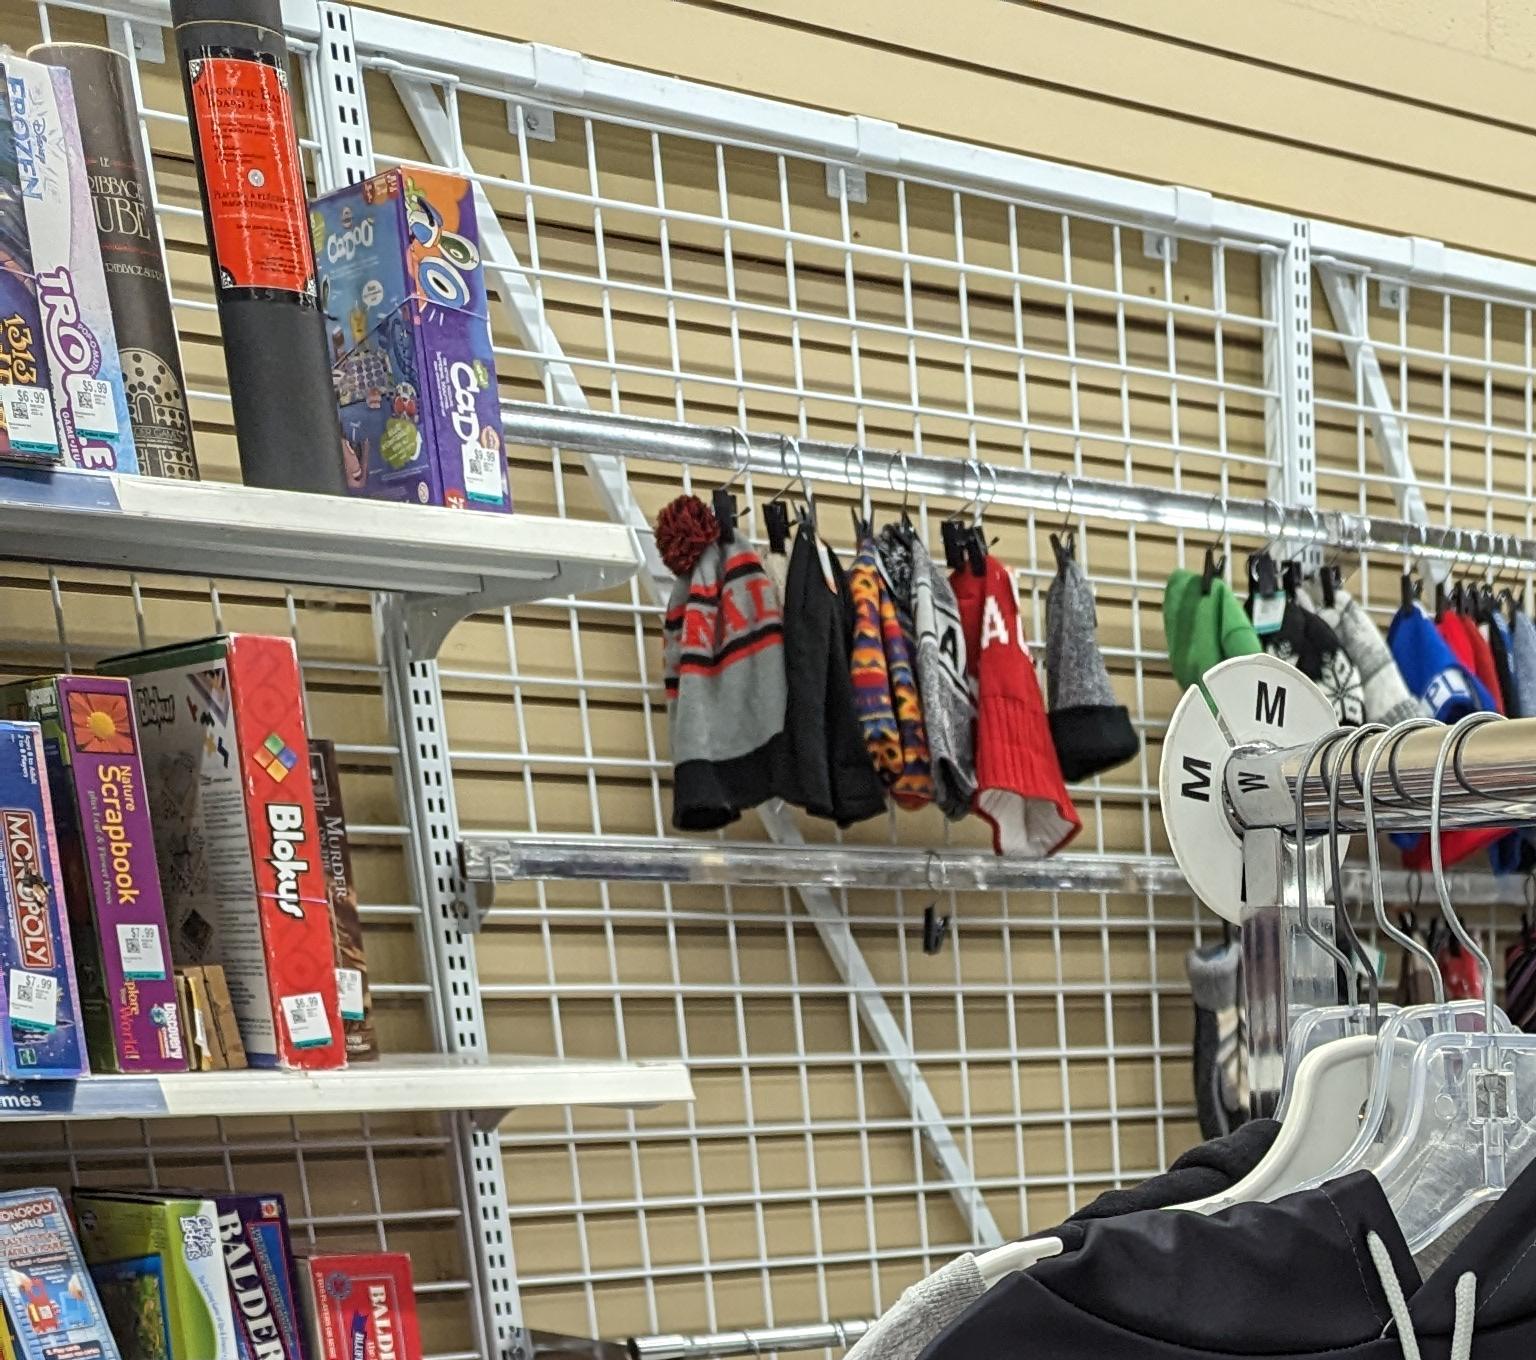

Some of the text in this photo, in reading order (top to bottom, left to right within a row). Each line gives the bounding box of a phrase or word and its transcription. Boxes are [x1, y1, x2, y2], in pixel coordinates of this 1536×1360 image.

[8, 76, 43, 201] FROZEN
[92, 198, 151, 240] UBE
[3, 313, 37, 384] 1313
[38, 270, 114, 468] TROE
[17, 389, 45, 404] $6.99
[82, 380, 108, 394] $5.99
[1256, 680, 1286, 728] M
[119, 765, 135, 812] Nature
[1181, 755, 1211, 803] M
[99, 764, 140, 905] Scrapbook
[267, 804, 306, 918] Blokus
[325, 816, 347, 903] MURDER
[26, 975, 52, 991] $7.99
[124, 980, 139, 1016] plore
